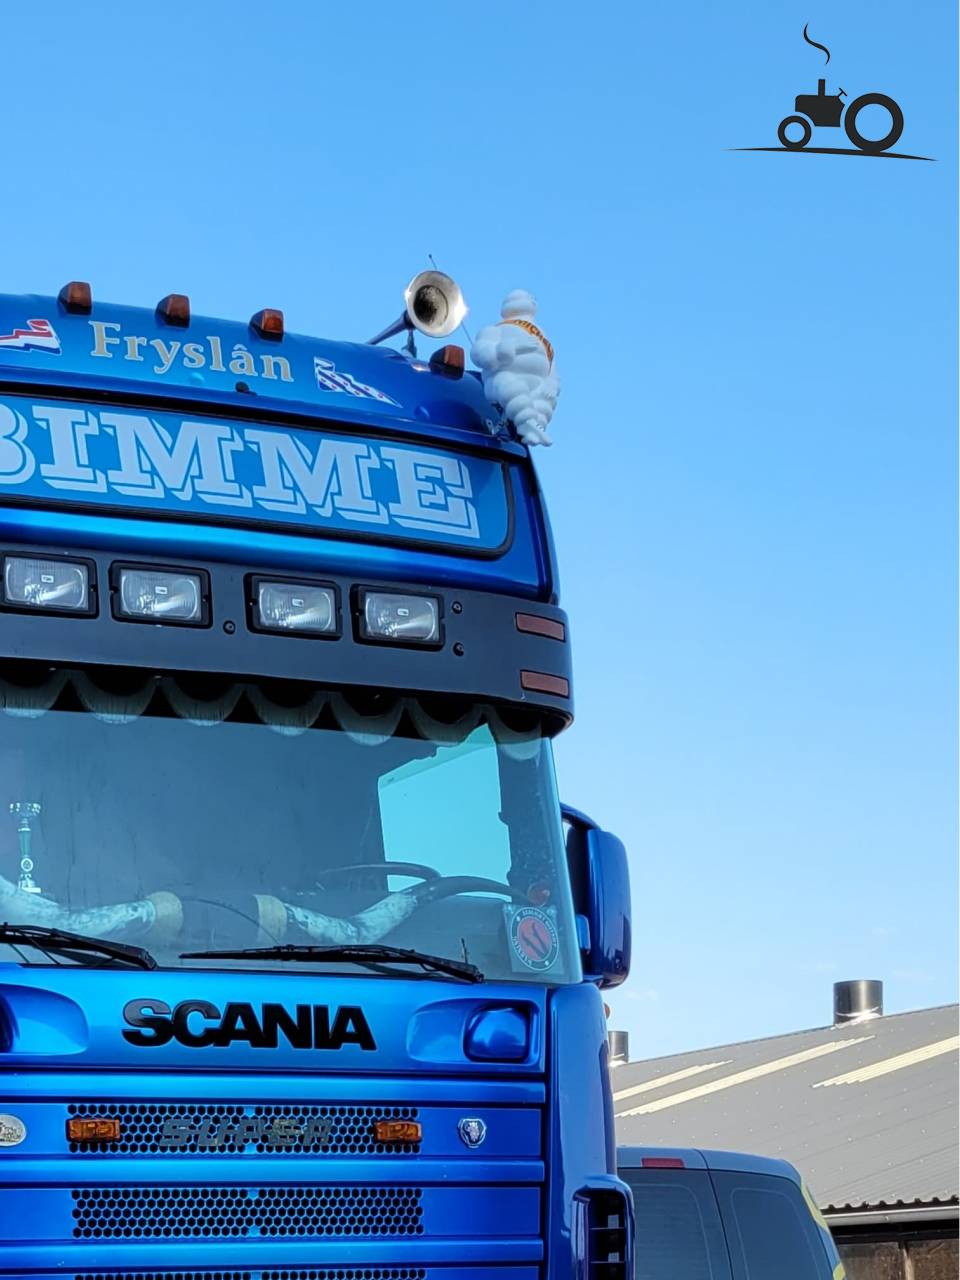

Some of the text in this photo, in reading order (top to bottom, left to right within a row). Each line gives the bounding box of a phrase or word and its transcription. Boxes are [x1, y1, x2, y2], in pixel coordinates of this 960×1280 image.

[88, 319, 295, 383] Fryslân
[121, 998, 377, 1051] SCANIA
[159, 1108, 332, 1147] SUPER
